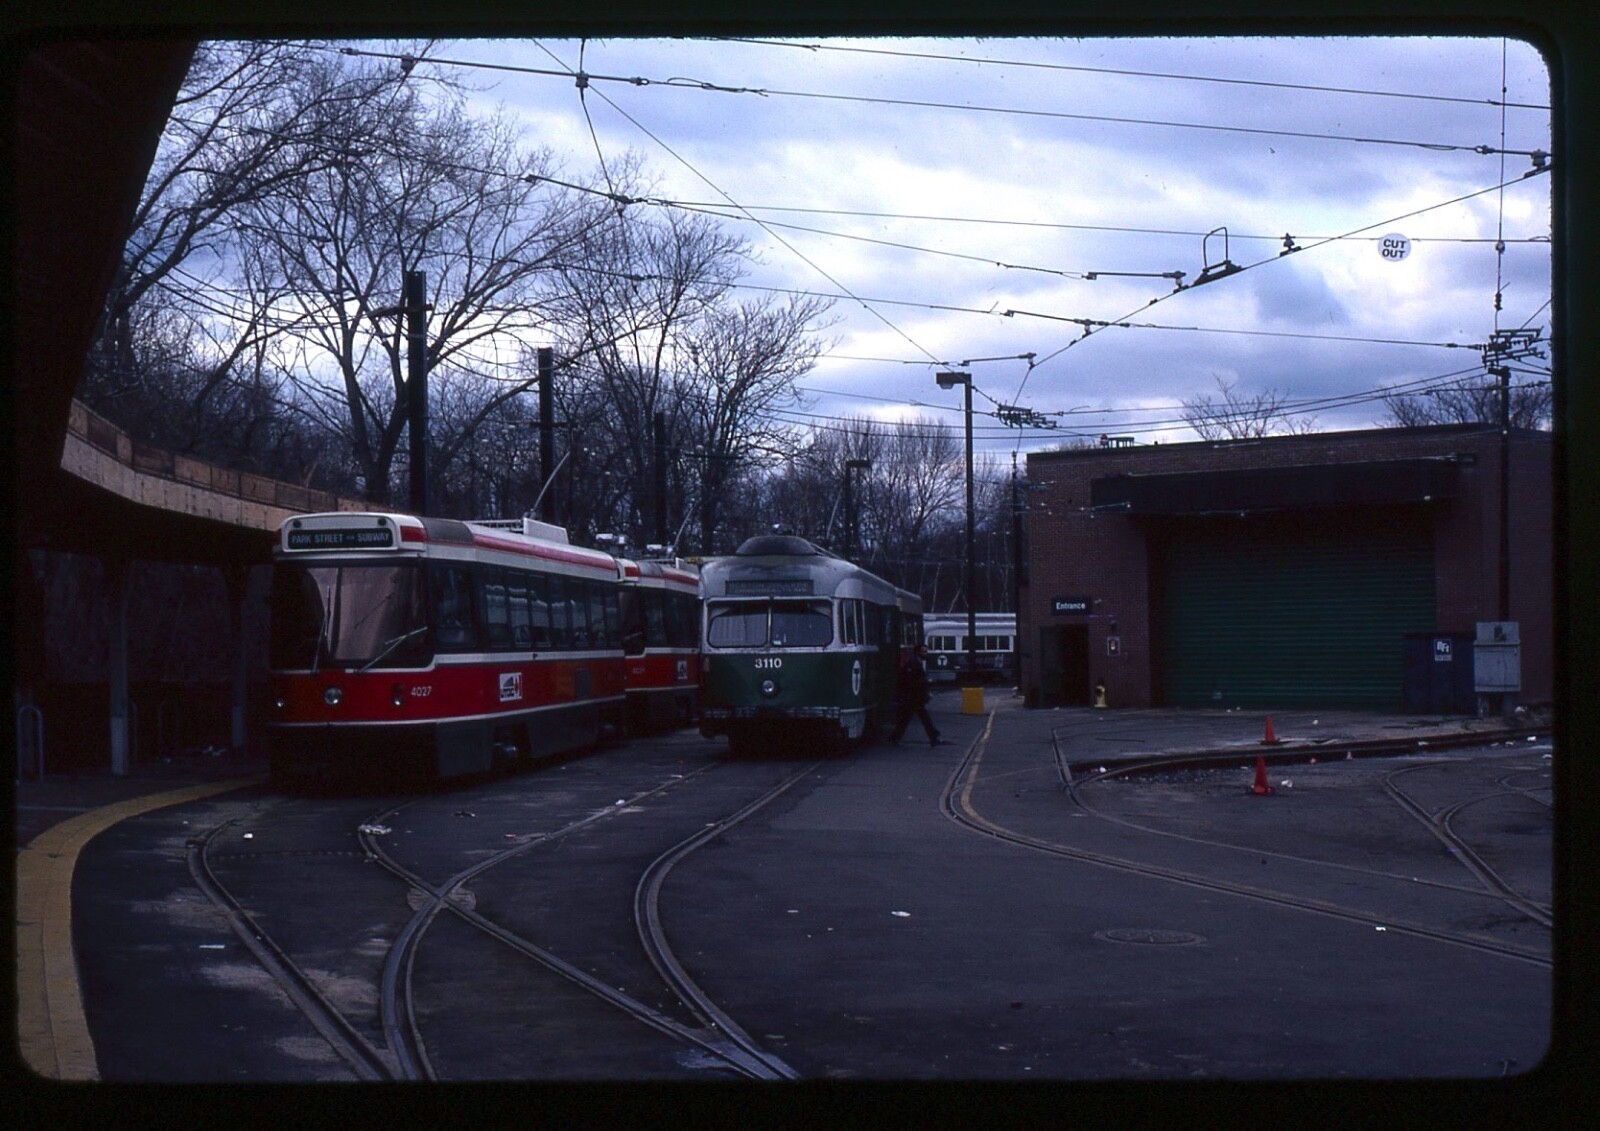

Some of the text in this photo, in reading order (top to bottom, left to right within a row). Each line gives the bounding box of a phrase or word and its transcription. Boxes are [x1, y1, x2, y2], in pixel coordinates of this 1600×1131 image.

[1383, 239, 1406, 249] CUT
[1382, 248, 1405, 258] OUT
[292, 534, 311, 544] PARK
[314, 533, 344, 543] STREET
[357, 532, 390, 542] SUBWAY
[1055, 601, 1086, 610] Entrance
[754, 657, 782, 669] 3110
[410, 686, 433, 697] 4027
